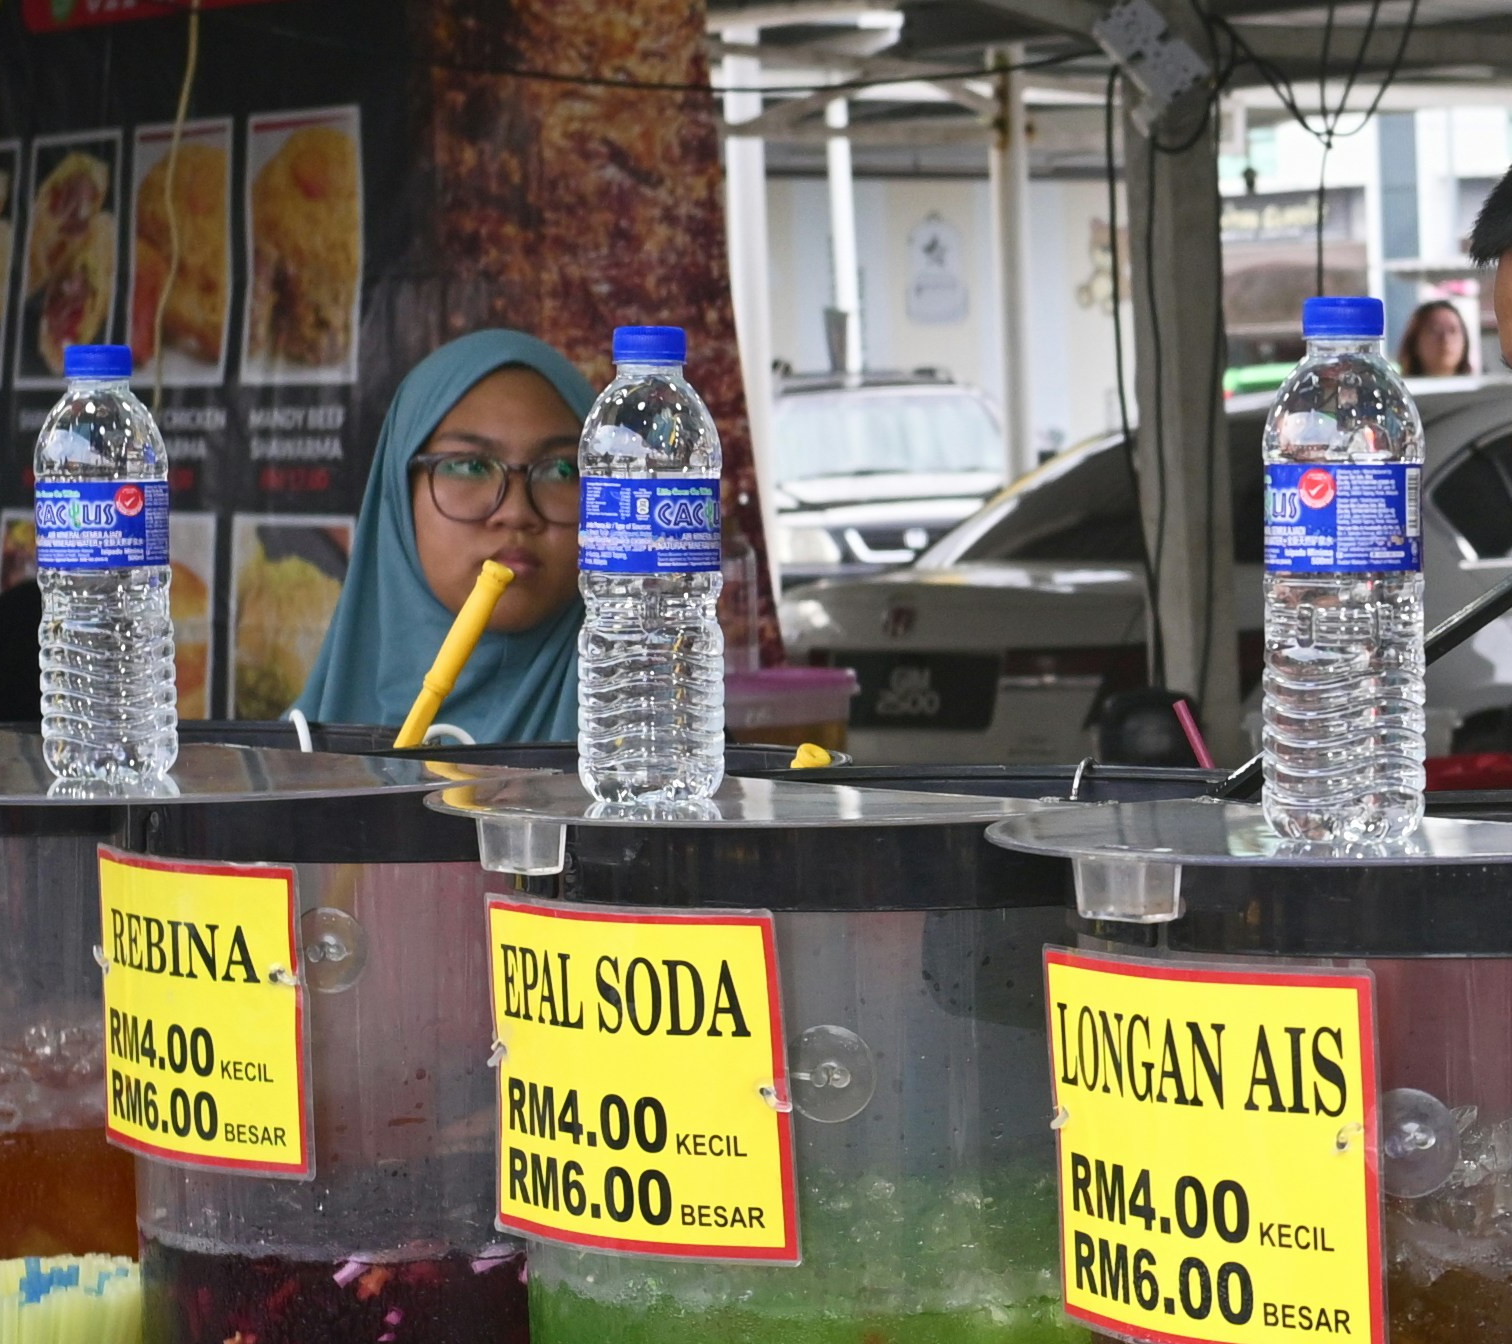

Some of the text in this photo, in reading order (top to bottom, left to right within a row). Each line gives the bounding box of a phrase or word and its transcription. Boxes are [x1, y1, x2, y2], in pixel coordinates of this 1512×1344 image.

[111, 907, 260, 984] REBINA
[500, 943, 751, 1038] EPAL SODA
[110, 1006, 274, 1084] RM4.00 KECIL
[1056, 1001, 1348, 1118] LONGAN AIS
[111, 1068, 287, 1148] RM6.00 BESAR
[508, 1077, 748, 1158] RM4.00 KECIL
[508, 1147, 766, 1230] RM6.00 BESAR
[1071, 1151, 1335, 1253] RM4.00 KECIL
[1074, 1230, 1352, 1336] RM6.00 BESAR
